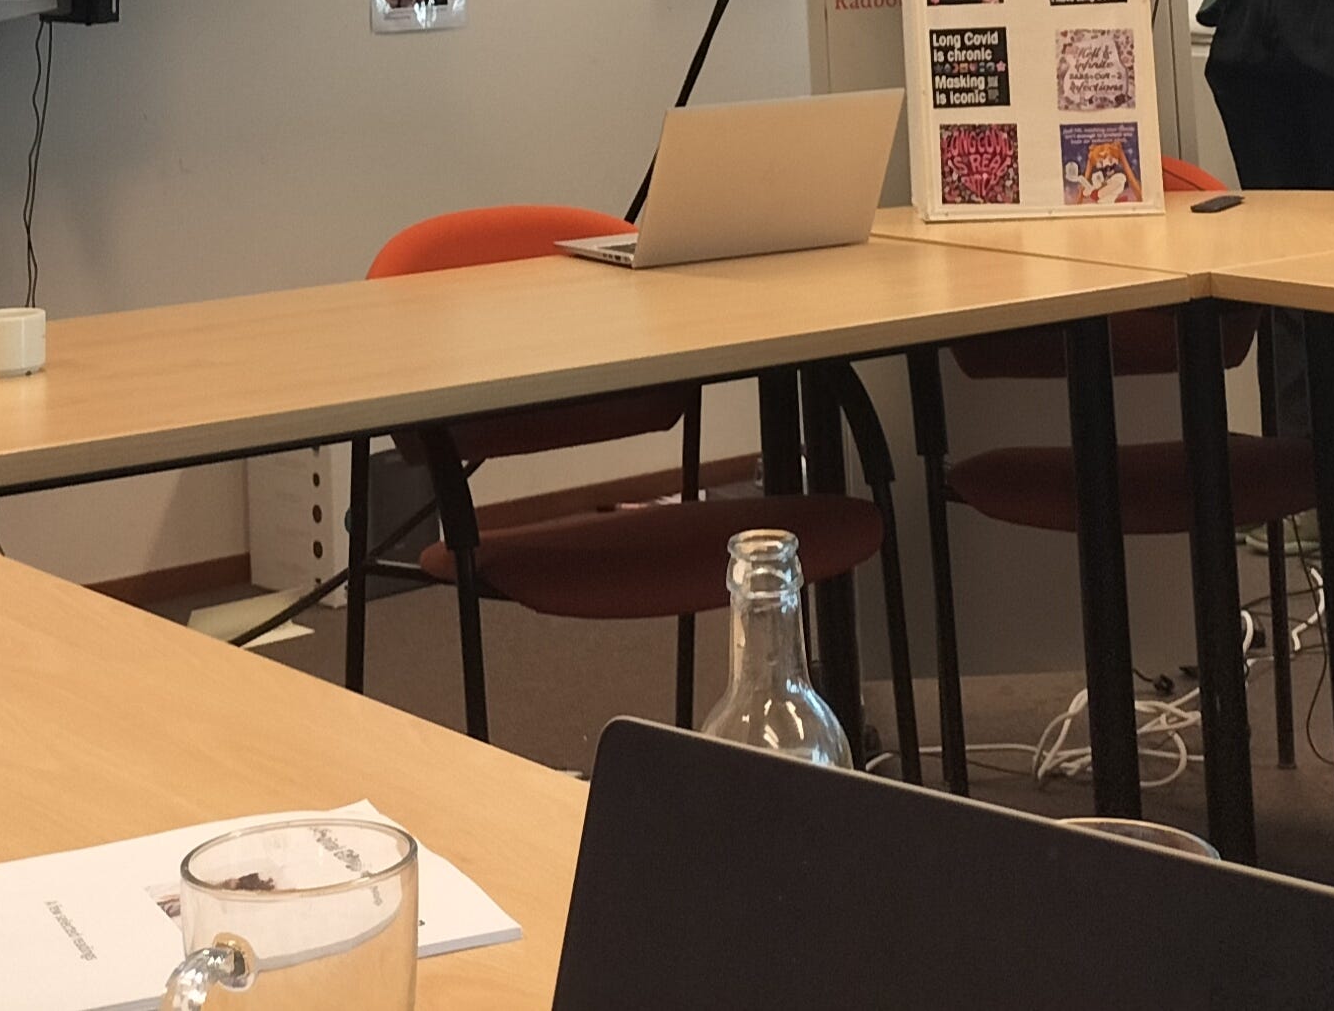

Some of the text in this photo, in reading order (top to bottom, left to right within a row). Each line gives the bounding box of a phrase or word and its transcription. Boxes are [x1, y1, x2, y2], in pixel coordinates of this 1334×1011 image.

[932, 30, 999, 49] Long Covid
[947, 46, 992, 62] chronic
[934, 74, 986, 90] Masking
